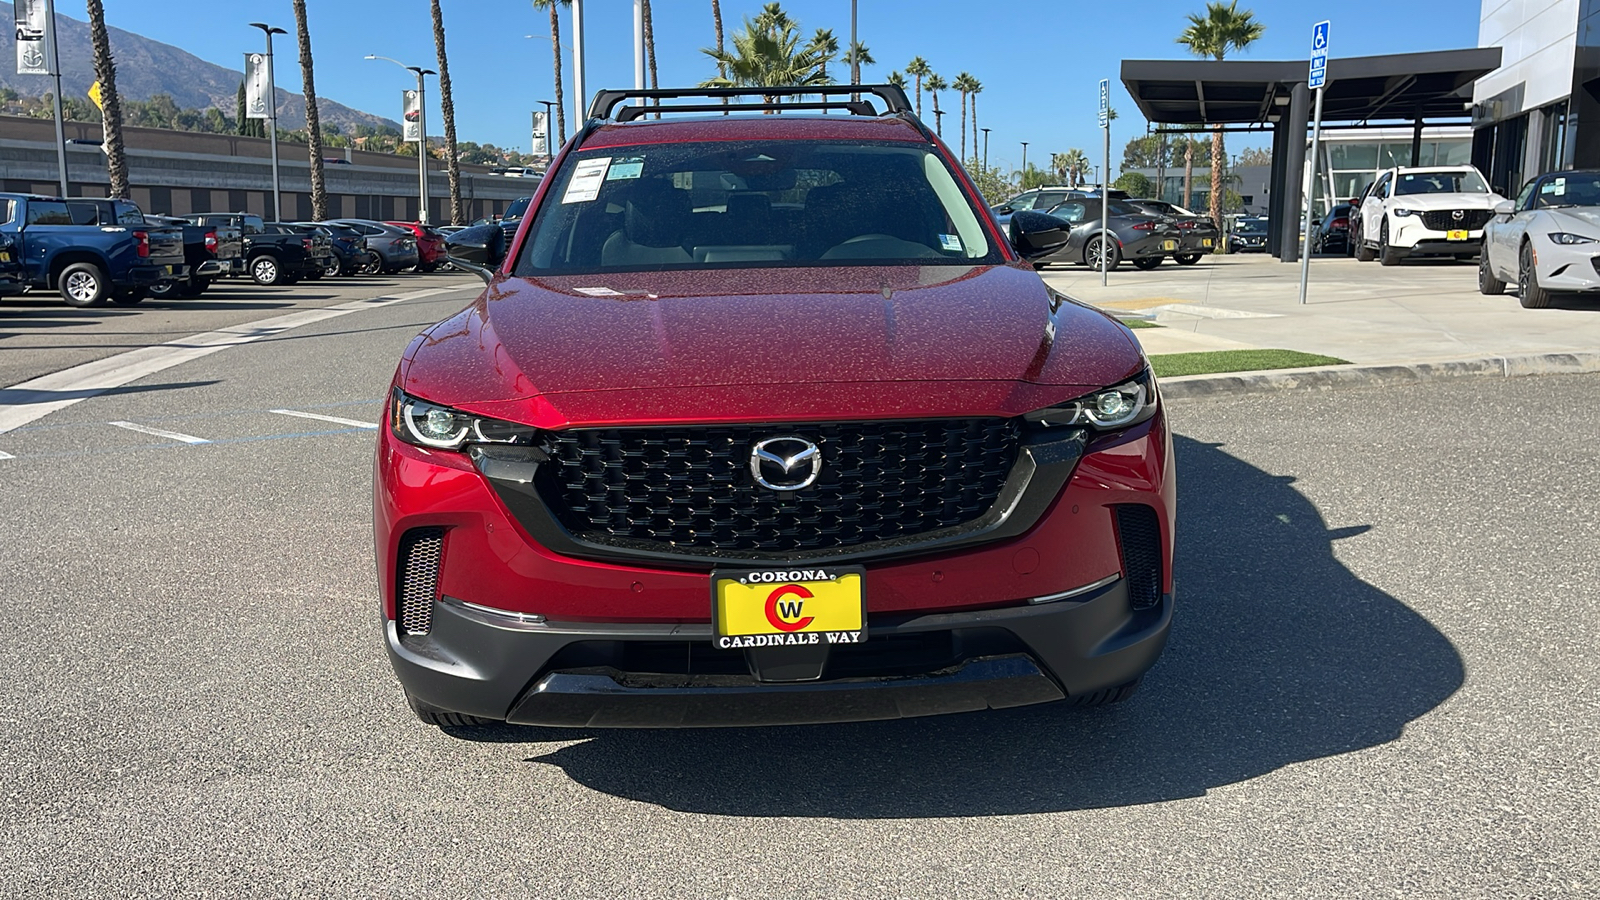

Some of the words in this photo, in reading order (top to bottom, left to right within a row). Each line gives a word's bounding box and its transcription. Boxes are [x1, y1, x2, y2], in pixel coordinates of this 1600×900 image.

[748, 569, 829, 583] CORONA
[719, 633, 820, 649] CARDINALE
[826, 632, 861, 645] WAY
